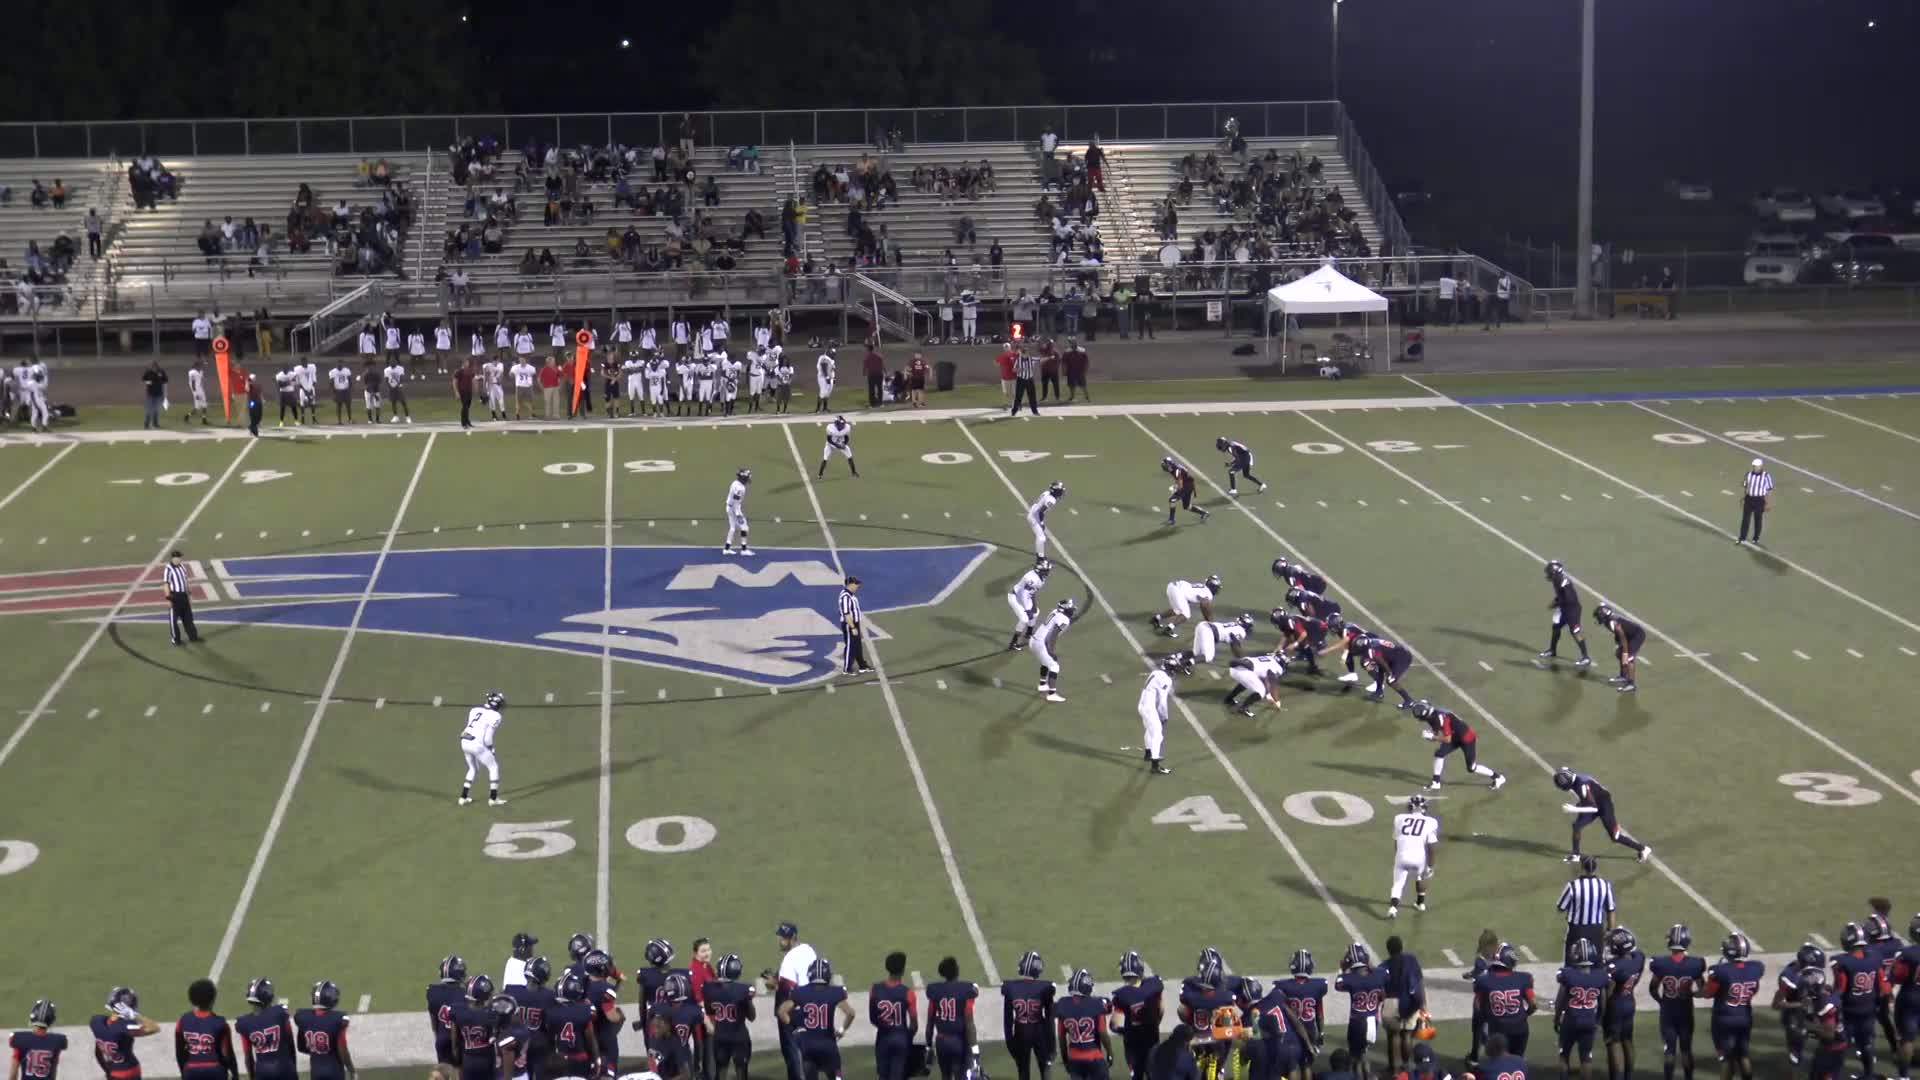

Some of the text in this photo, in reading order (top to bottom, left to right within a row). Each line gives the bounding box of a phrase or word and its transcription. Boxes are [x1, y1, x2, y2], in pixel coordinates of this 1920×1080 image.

[1013, 324, 1022, 339] 2
[468, 712, 483, 729] 2
[1401, 817, 1426, 837] 20
[878, 999, 902, 1026] 21
[939, 997, 957, 1022] 11
[1012, 999, 1041, 1024] 25
[1489, 988, 1521, 1017] 65
[803, 1002, 829, 1030] 31
[249, 1024, 281, 1054] 27
[561, 1022, 576, 1048] 4
[26, 1049, 52, 1078] 15
